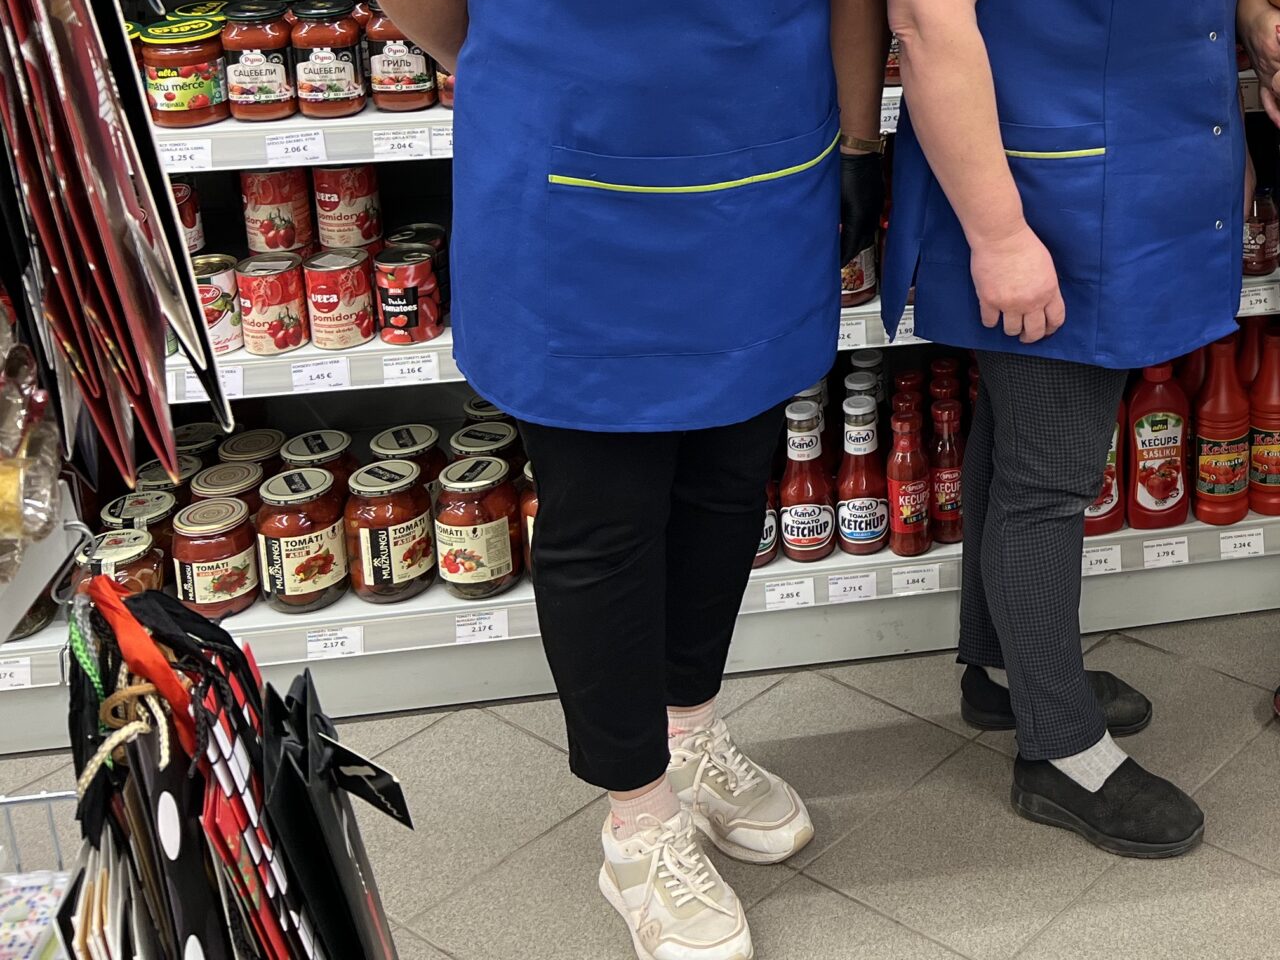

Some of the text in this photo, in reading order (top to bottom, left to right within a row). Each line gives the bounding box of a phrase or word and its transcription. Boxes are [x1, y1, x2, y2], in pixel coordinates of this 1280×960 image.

[382, 58, 412, 69] ГРИЛЬ
[233, 68, 277, 78] САЦЕБЕЛИ
[303, 66, 347, 76] САЦЕБЕЛИ
[172, 79, 205, 92] mērce
[284, 146, 301, 154] 2.06
[310, 293, 339, 304] vera
[382, 304, 417, 313] Tomatoes
[313, 311, 359, 324] pomidory
[1141, 435, 1178, 448] KEČUPS
[1142, 447, 1178, 459] ŠAŠLIKU
[849, 511, 877, 520] TOMATO
[392, 518, 426, 536] TOMĀTI
[791, 518, 820, 526] TOMATO
[841, 514, 886, 532] KETCHUP
[436, 524, 463, 537] TOMĀTI
[784, 522, 829, 538] KETCHUP
[285, 533, 323, 547] TOMĀTI
[1157, 550, 1169, 558] 1.79
[195, 561, 229, 572] TOMĀTI
